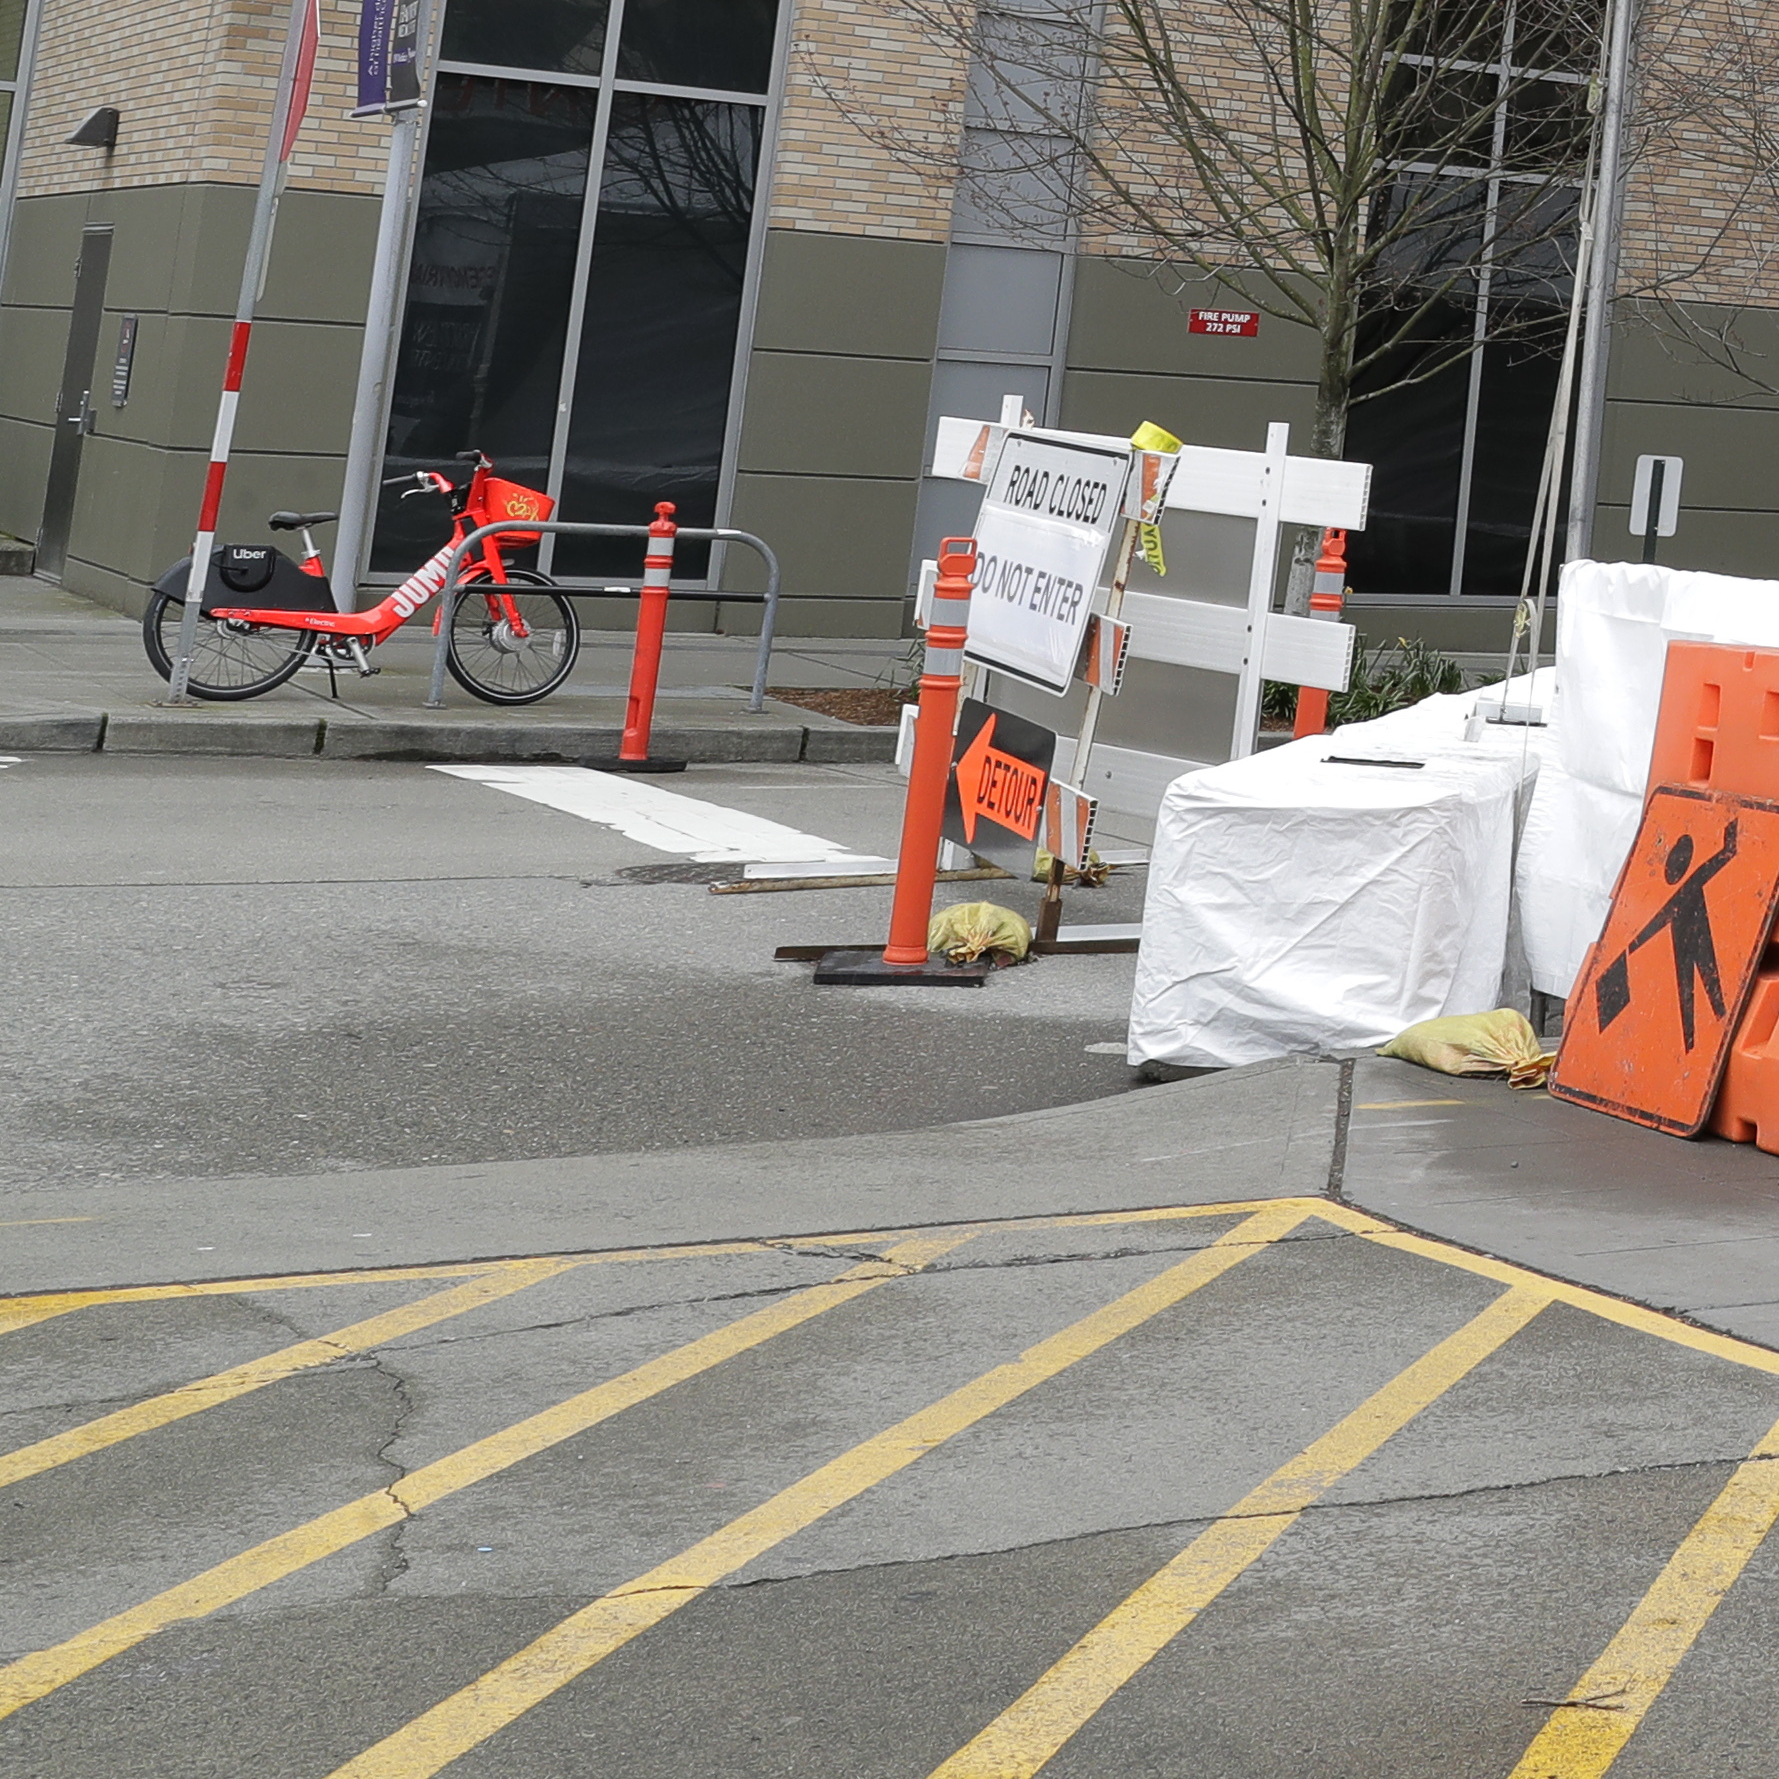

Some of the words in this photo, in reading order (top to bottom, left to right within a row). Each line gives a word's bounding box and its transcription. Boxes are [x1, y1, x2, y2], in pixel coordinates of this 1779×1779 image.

[1198, 311, 1219, 321] FIRE
[1221, 313, 1251, 323] PUMP
[1206, 323, 1223, 332] 272
[1226, 324, 1241, 333] PSI
[1003, 465, 1049, 510] ROAD
[1050, 474, 1107, 525] CLOSED
[233, 548, 266, 559] Uber
[971, 551, 997, 594] DO
[994, 563, 1034, 606] NOT
[1029, 570, 1084, 625] ENTER
[977, 755, 1037, 830] DETOUR
